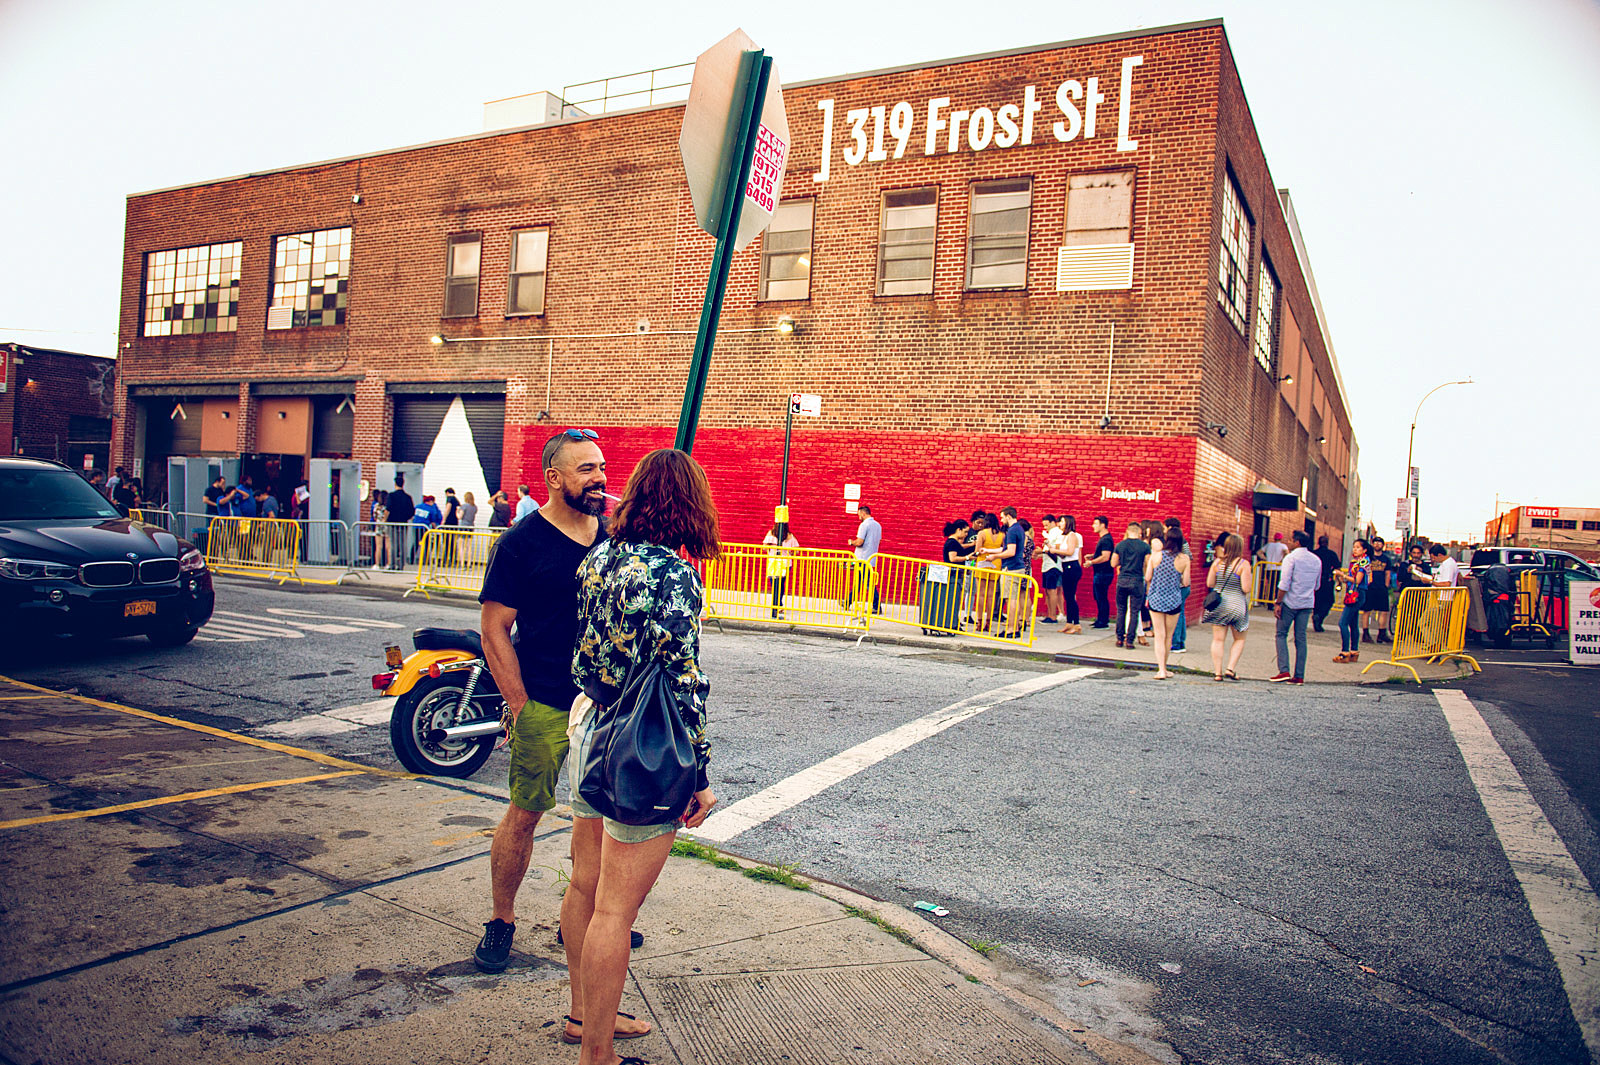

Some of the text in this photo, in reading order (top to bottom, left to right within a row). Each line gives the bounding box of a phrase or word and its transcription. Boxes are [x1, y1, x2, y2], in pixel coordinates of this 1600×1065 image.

[843, 101, 914, 166] 319
[924, 85, 1042, 156] Frost
[1052, 76, 1105, 143] St
[758, 126, 785, 156] CASH
[753, 153, 778, 182] (917)
[753, 170, 773, 195] 515
[745, 182, 774, 212] 6499
[1106, 489, 1137, 501] Brooklyn
[1579, 610, 1600, 619] PRE
[1575, 633, 1600, 642] PART
